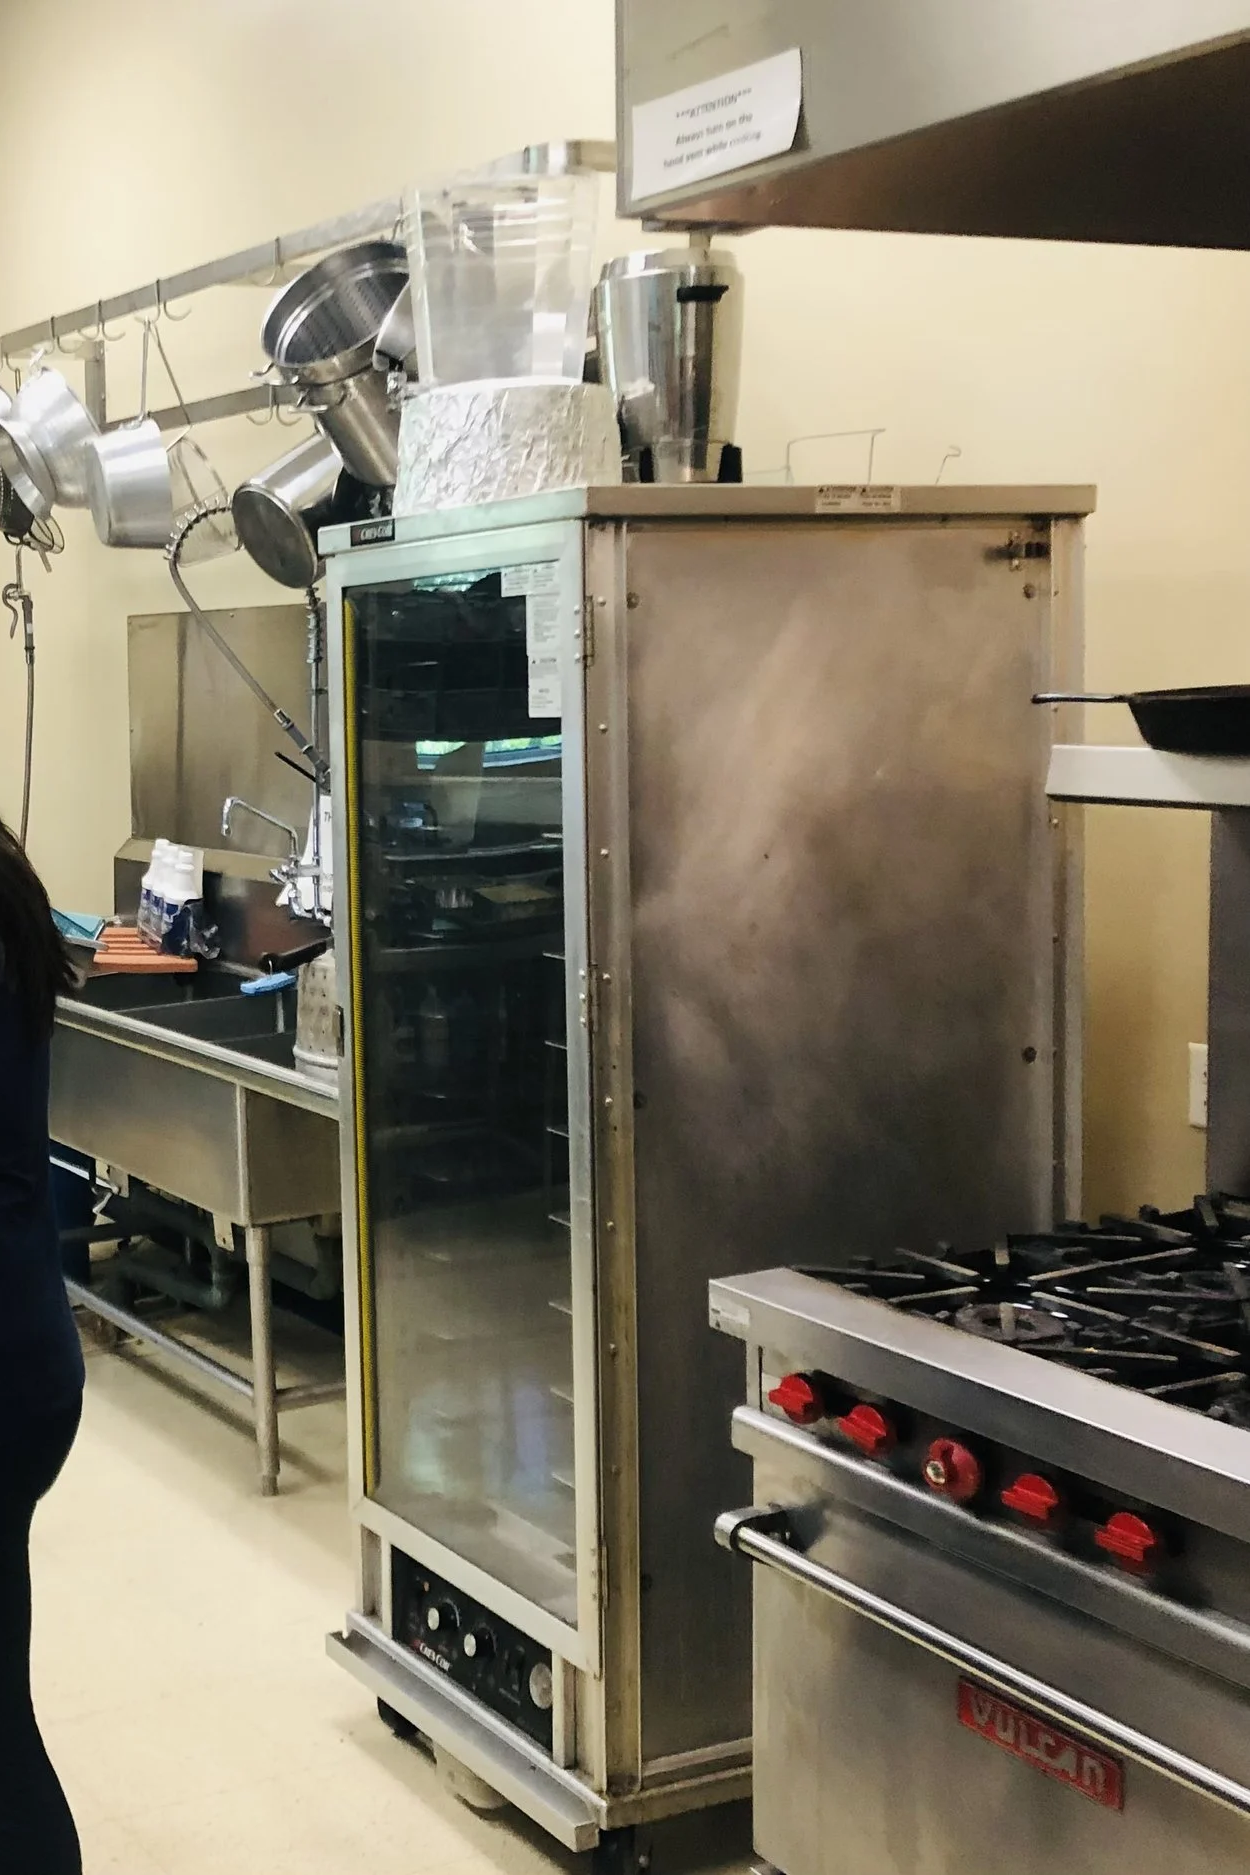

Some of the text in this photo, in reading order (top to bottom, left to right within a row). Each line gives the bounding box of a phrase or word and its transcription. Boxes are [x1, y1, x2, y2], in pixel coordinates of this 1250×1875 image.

[676, 112, 753, 146] Always turn on the
[970, 1692, 1105, 1795] VULCAN
